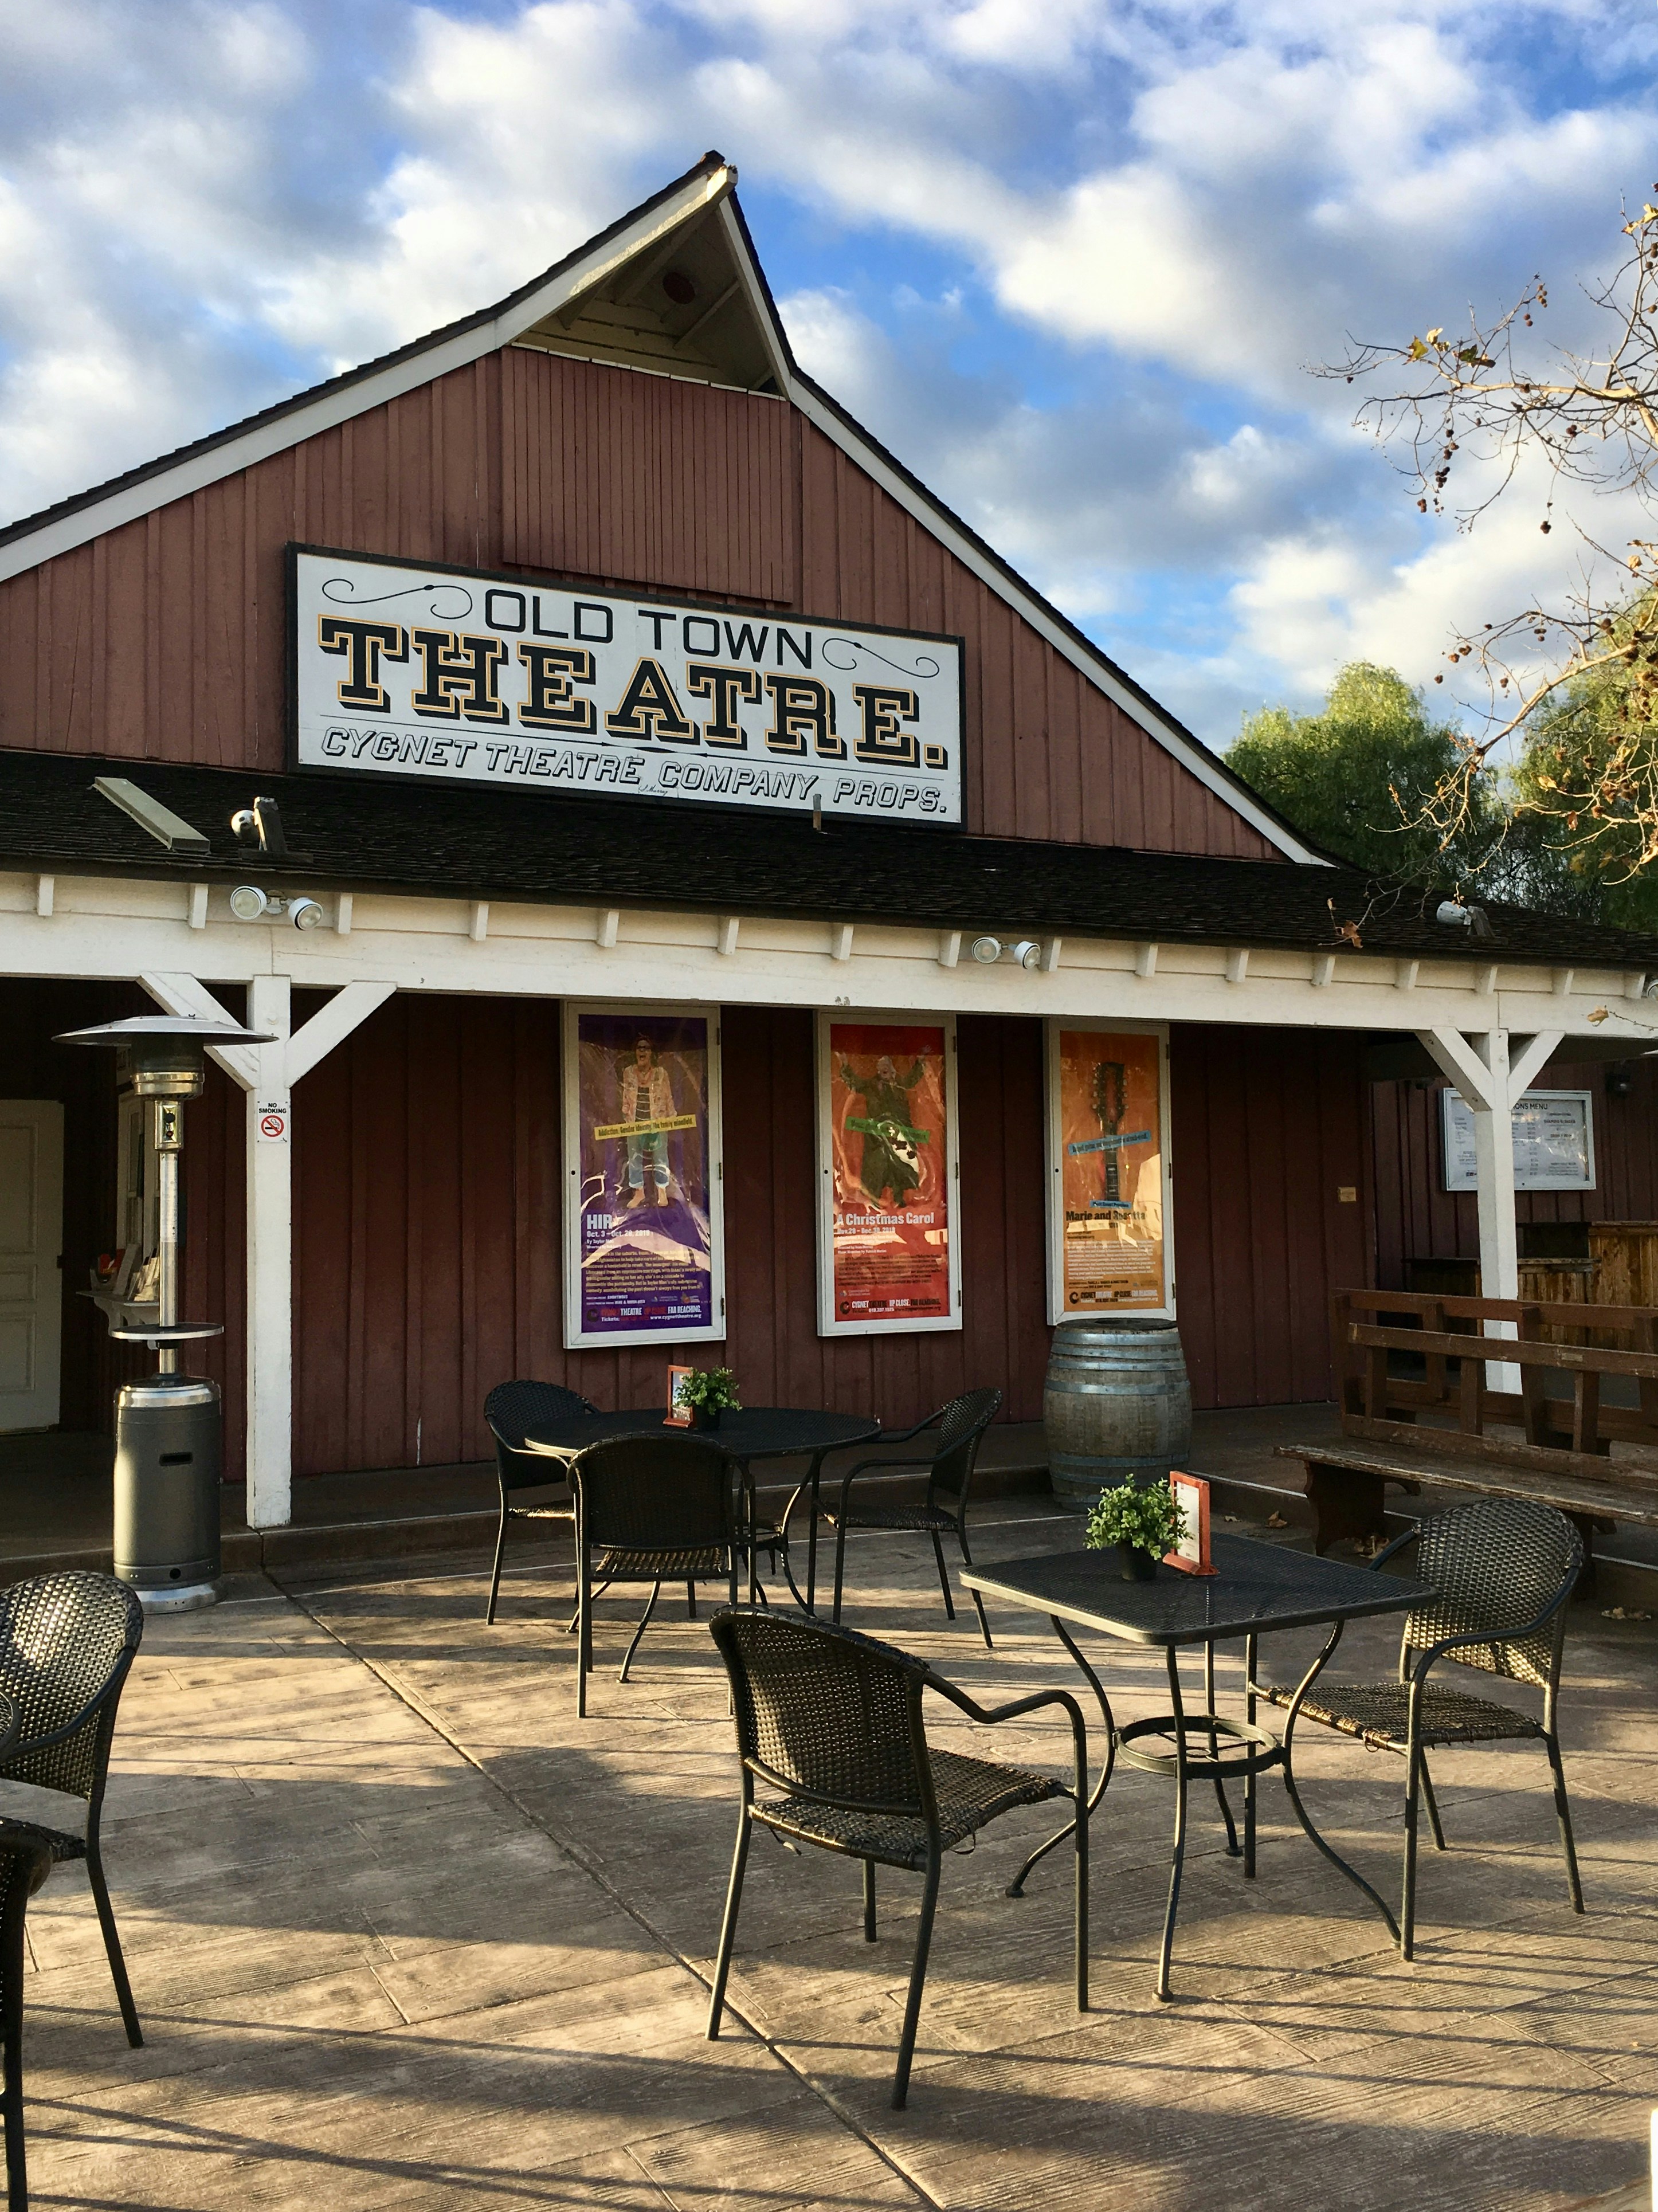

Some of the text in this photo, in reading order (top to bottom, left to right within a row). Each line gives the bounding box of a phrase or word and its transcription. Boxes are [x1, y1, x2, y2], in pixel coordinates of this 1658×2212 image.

[485, 588, 813, 670] OLD TOWN
[318, 613, 949, 772] THEATRE.
[320, 727, 947, 814] CYGNET THEATRE COMPANY PROPS.
[587, 1214, 613, 1230] HIR
[837, 1212, 934, 1226] A Christmas Carol
[1066, 1211, 1092, 1221] Marie
[1095, 1210, 1111, 1220] and
[621, 1308, 642, 1316] THEATRE
[852, 1301, 869, 1309] CYGNET
